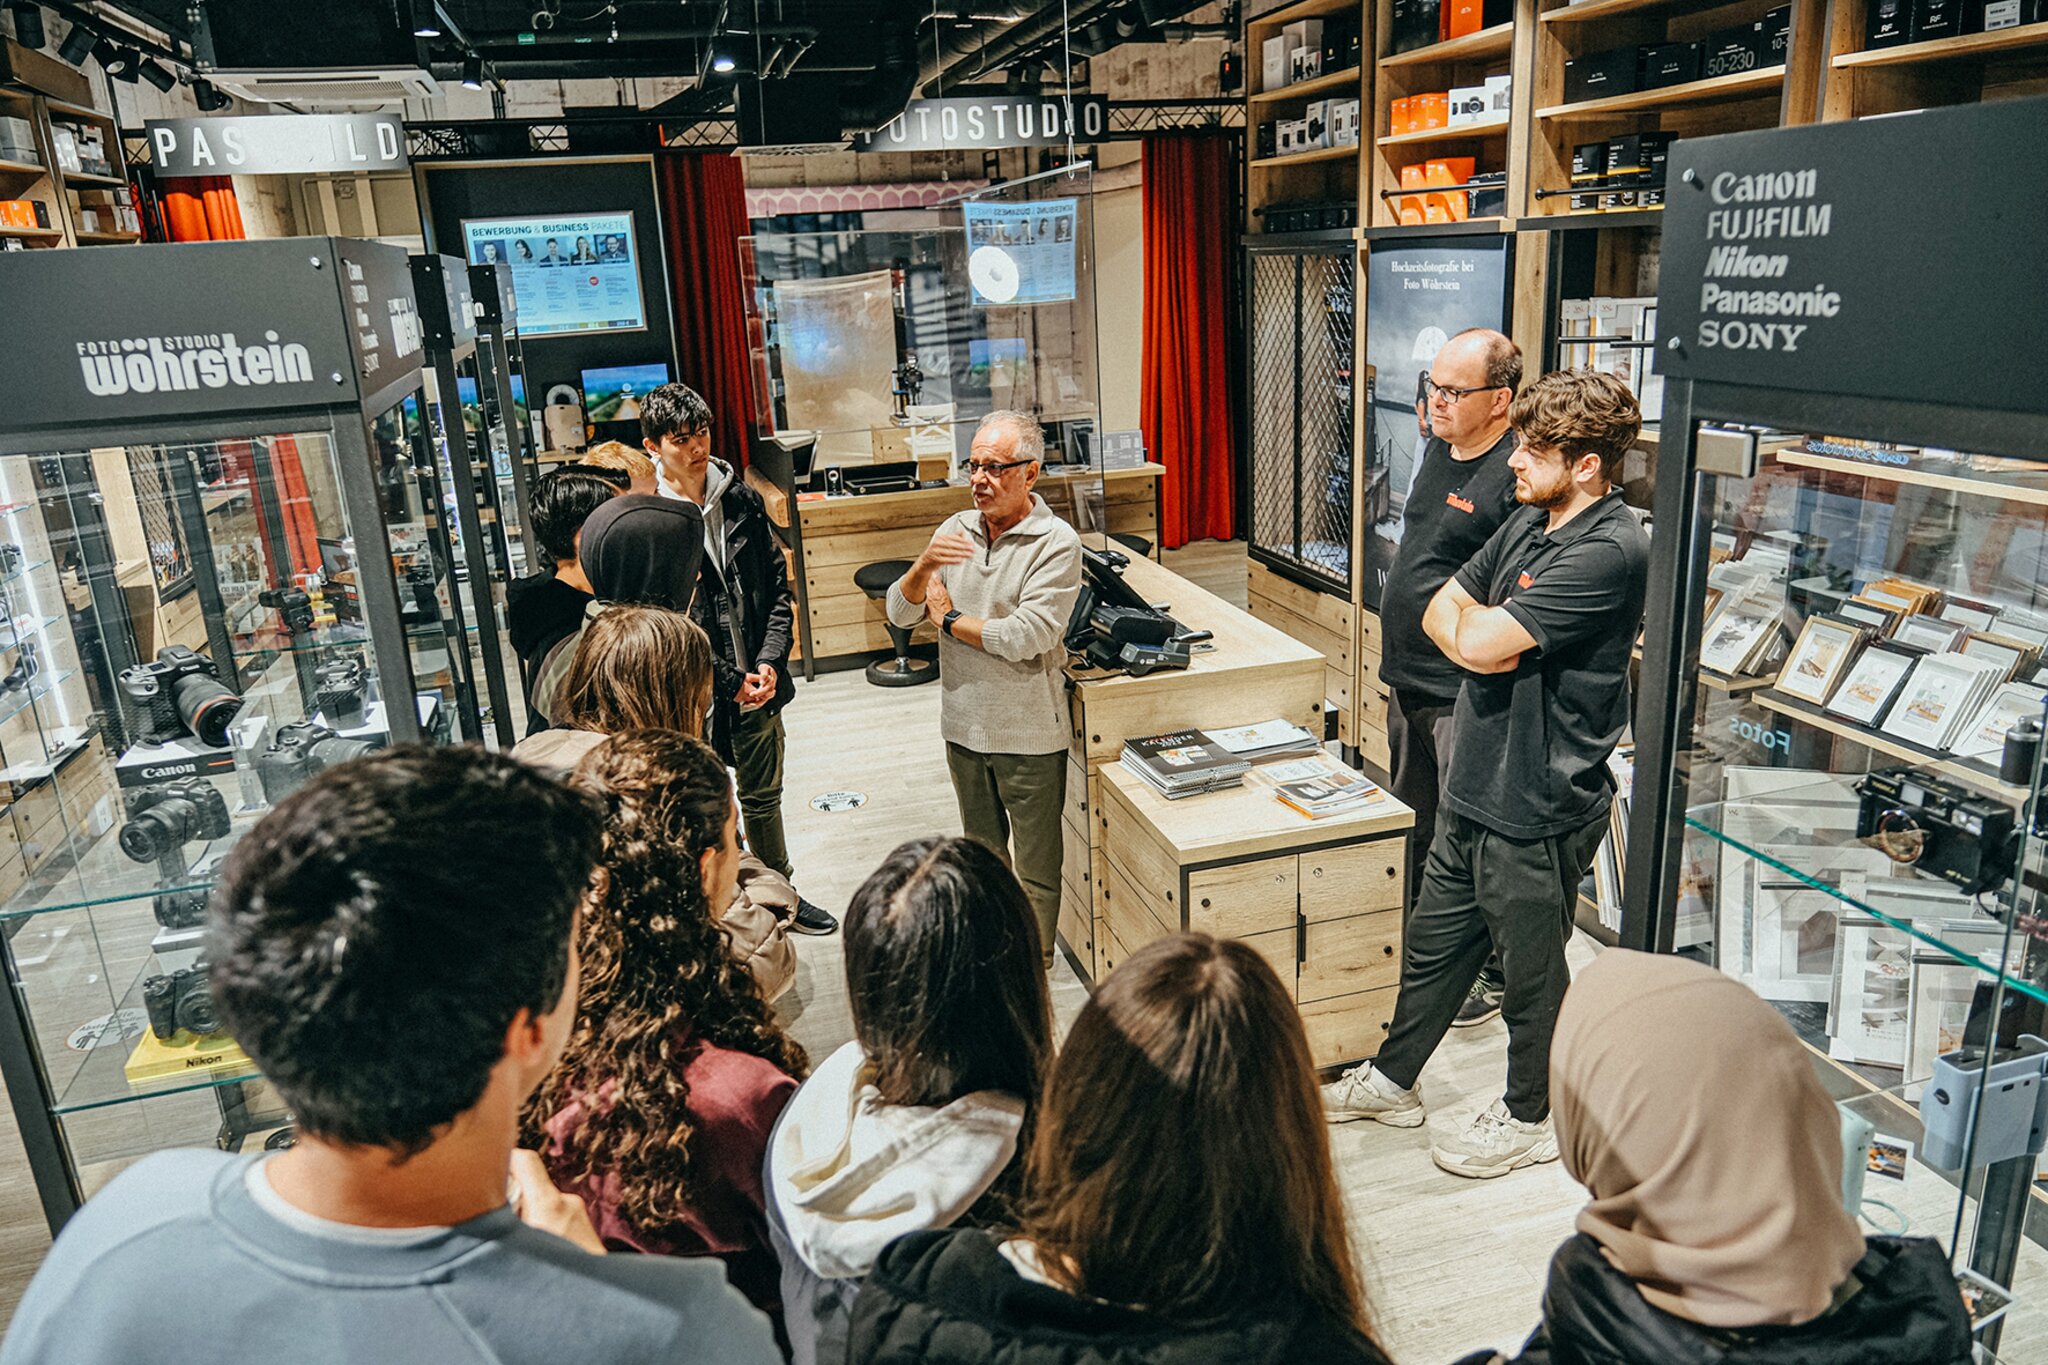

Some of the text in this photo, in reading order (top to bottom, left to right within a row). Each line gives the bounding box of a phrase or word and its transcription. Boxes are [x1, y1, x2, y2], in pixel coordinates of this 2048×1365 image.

[1880, 23, 1893, 32] RF
[1707, 51, 1755, 76] 50-230
[1711, 168, 1817, 204] Canon
[472, 226, 532, 236] BEWERBUNG
[542, 223, 589, 232] BUSINESS
[591, 221, 626, 230] PAKETE
[1706, 204, 1832, 240] FUJIFILM
[1391, 260, 1474, 275] Hochzeitsfotografie bei
[1703, 245, 1789, 278] Nikon
[1403, 278, 1460, 290] Foto Wöhrstein
[1700, 283, 1841, 317] Panasonic
[76, 334, 221, 355] FOTO STUDIO
[1698, 320, 1807, 351] SONY
[80, 330, 314, 396] wöhrstein
[141, 763, 197, 779] Canon
[186, 1056, 222, 1067] Nikon
